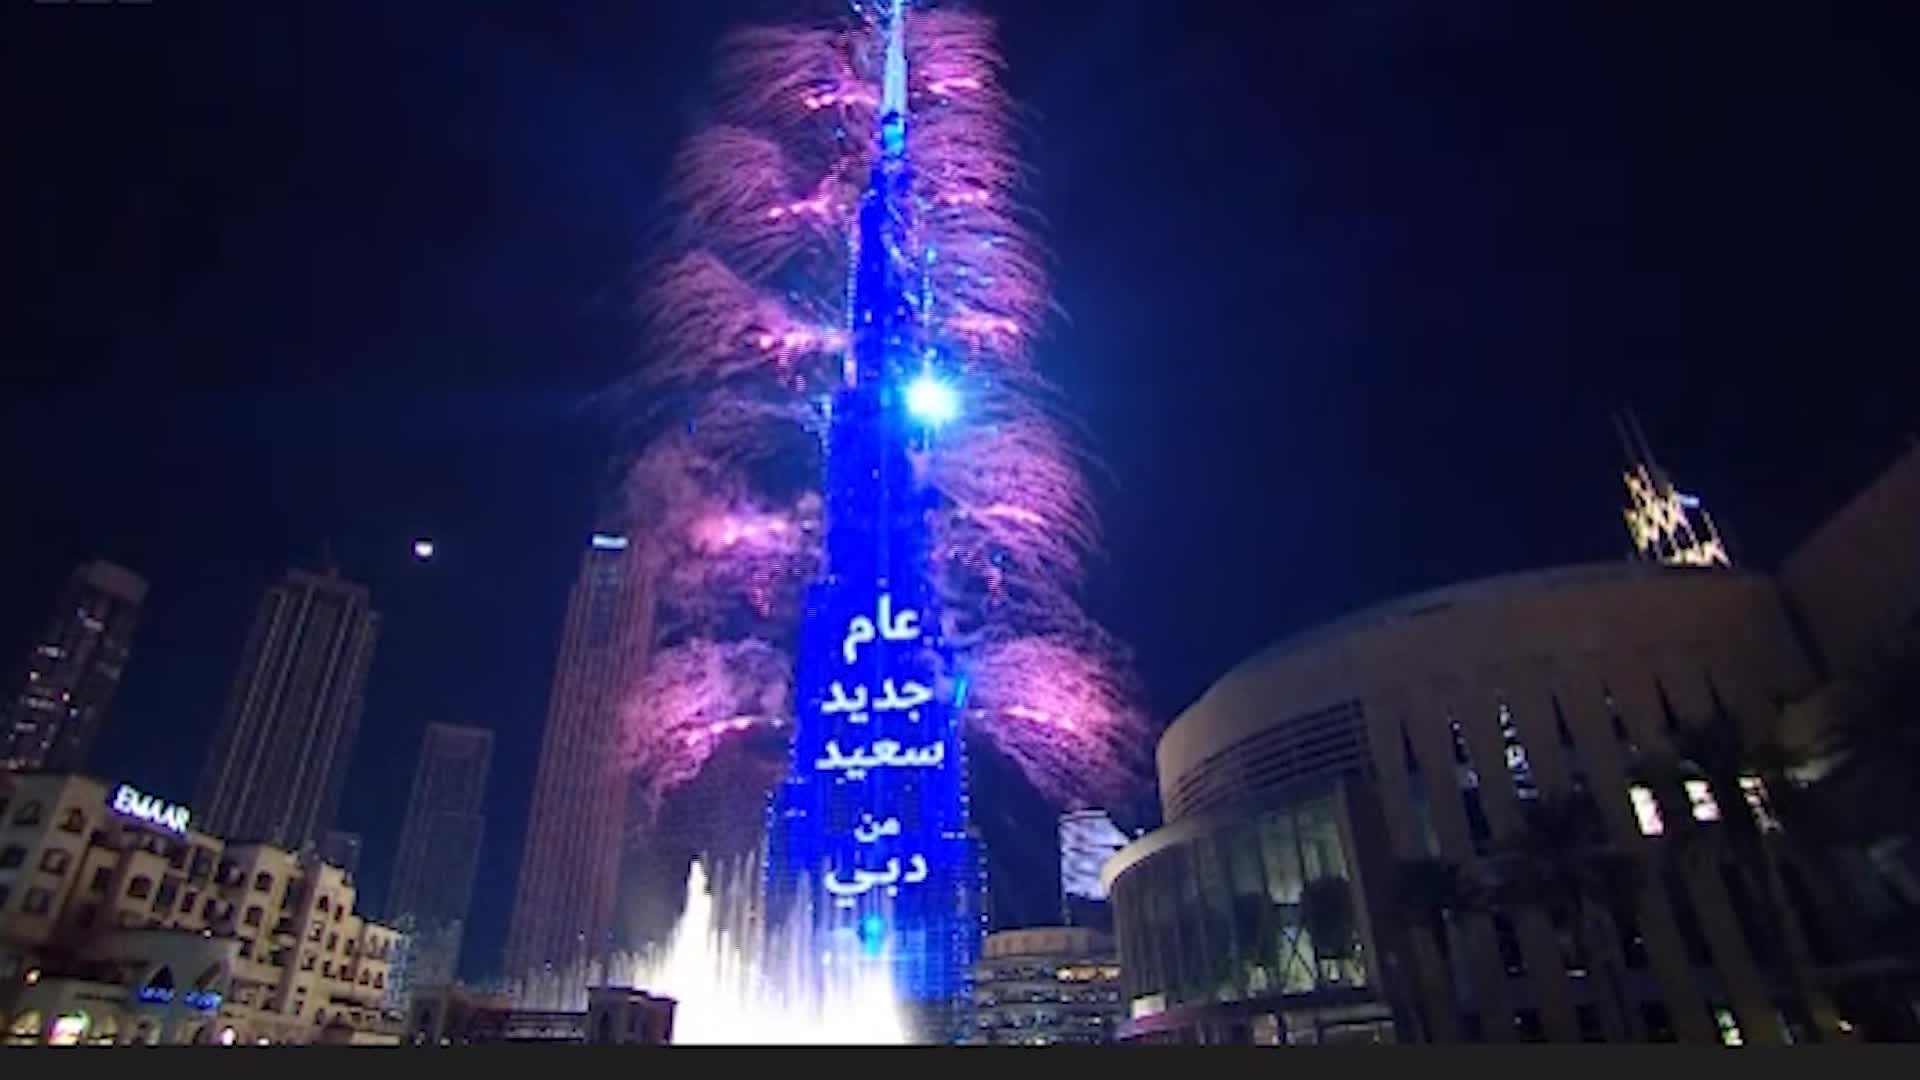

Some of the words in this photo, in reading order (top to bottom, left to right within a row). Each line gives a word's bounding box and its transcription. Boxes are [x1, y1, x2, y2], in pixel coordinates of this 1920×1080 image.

[843, 593, 920, 664] عام
[820, 677, 933, 724] جديد
[814, 739, 945, 781] سعيد
[112, 783, 191, 832] EMAAR
[854, 812, 900, 843] من
[824, 853, 928, 908] دبي
